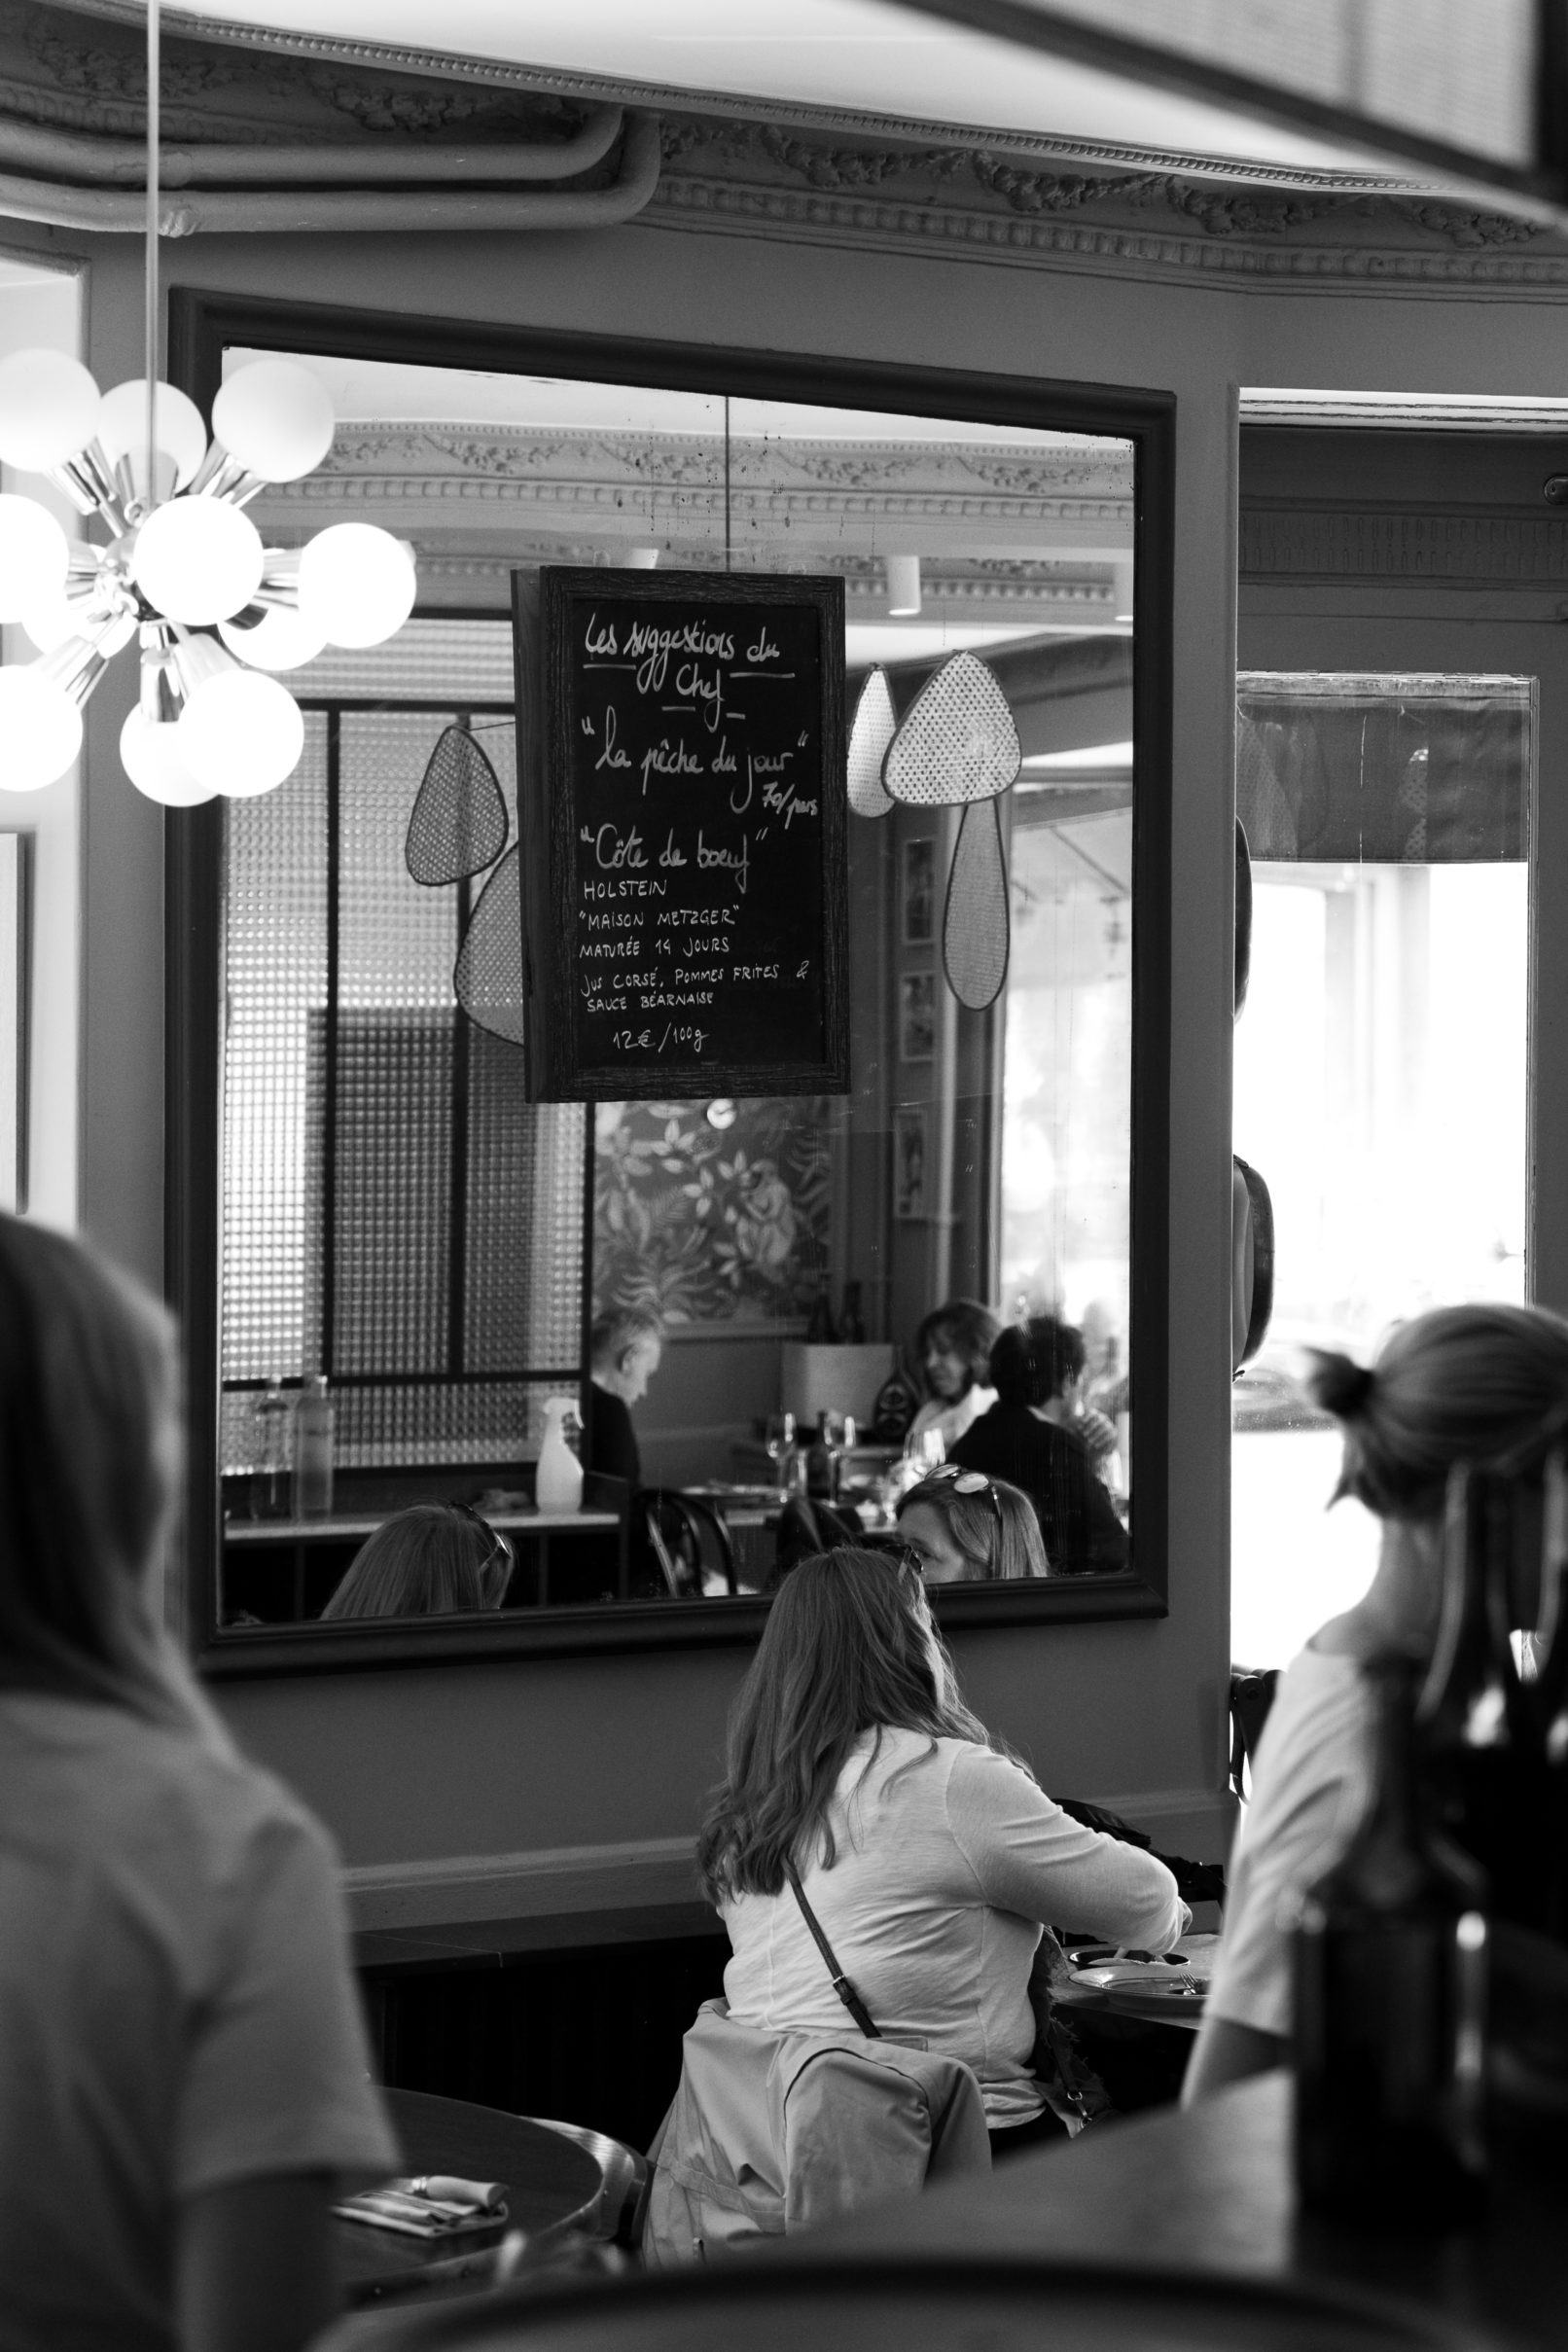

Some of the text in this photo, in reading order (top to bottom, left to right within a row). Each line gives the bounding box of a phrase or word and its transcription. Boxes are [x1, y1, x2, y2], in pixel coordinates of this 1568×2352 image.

[586, 613, 779, 694] Les suggestions du
[676, 663, 726, 732] Chef
[641, 738, 703, 796] pêche
[712, 735, 737, 771] du
[659, 828, 688, 867] de
[584, 879, 666, 901] HOLSTEIN
[580, 936, 729, 958] MATURÉE 14 JOURS
[797, 960, 809, 980] &
[588, 997, 626, 1012] SAUCE
